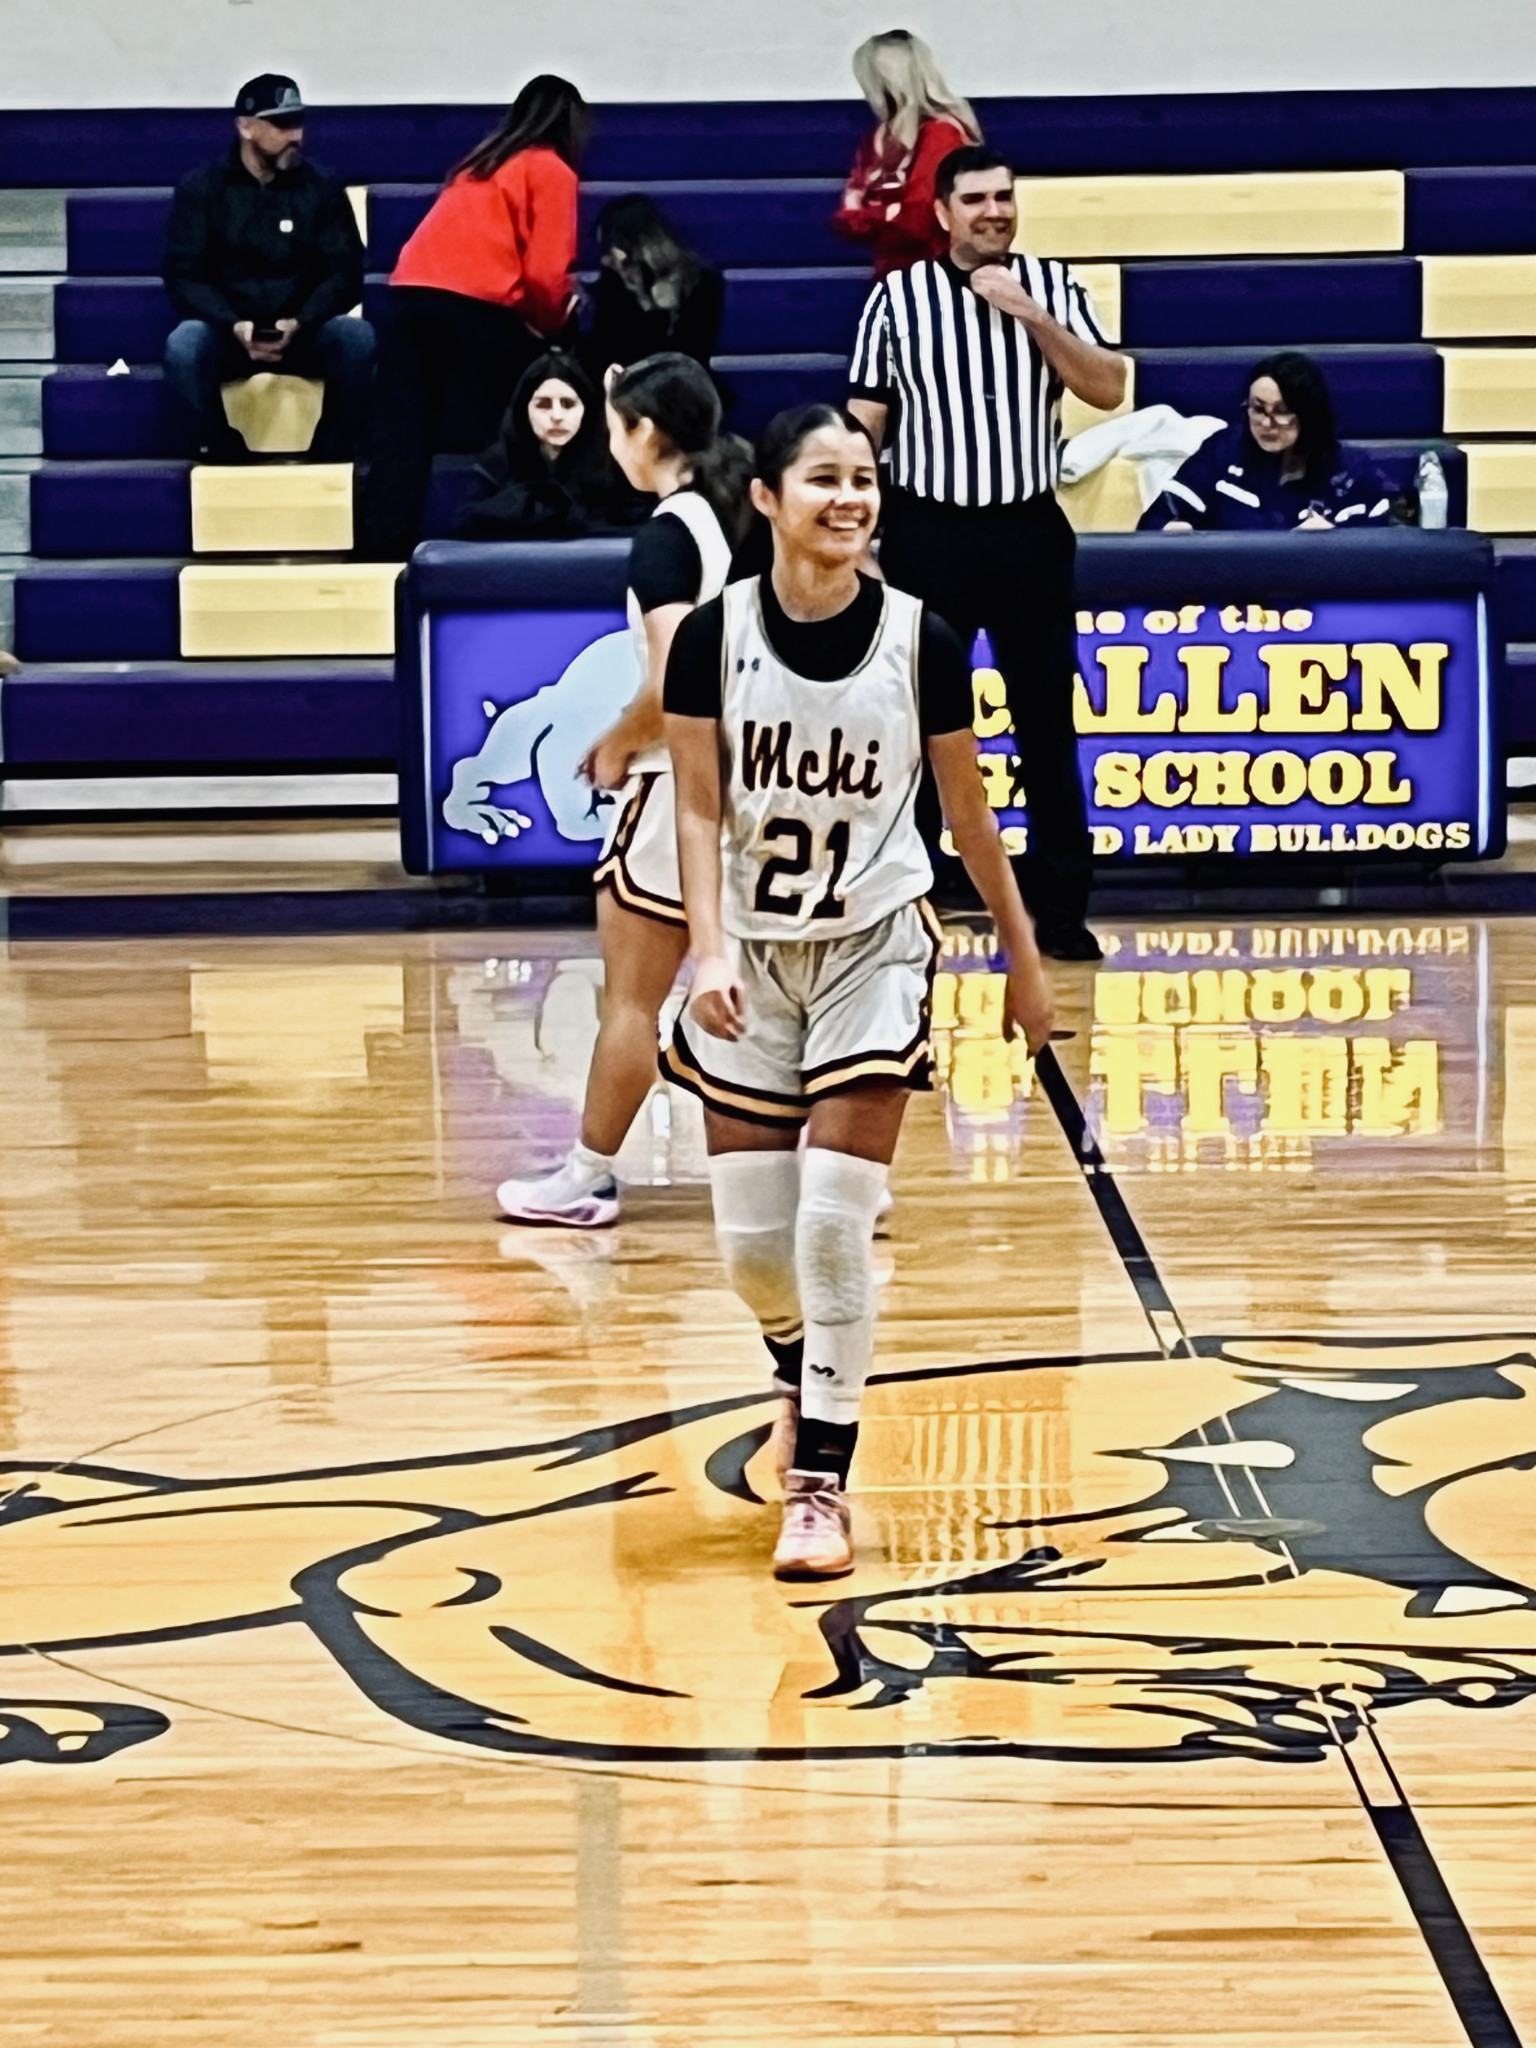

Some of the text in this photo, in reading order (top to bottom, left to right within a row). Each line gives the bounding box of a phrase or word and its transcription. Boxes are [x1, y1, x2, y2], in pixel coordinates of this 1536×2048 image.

[1143, 605, 1205, 634] of
[1094, 750, 1411, 808] SCHOOL
[1134, 824, 1240, 854] LADY
[1250, 822, 1470, 852] BULLDOGS
[754, 817, 850, 918] 21
